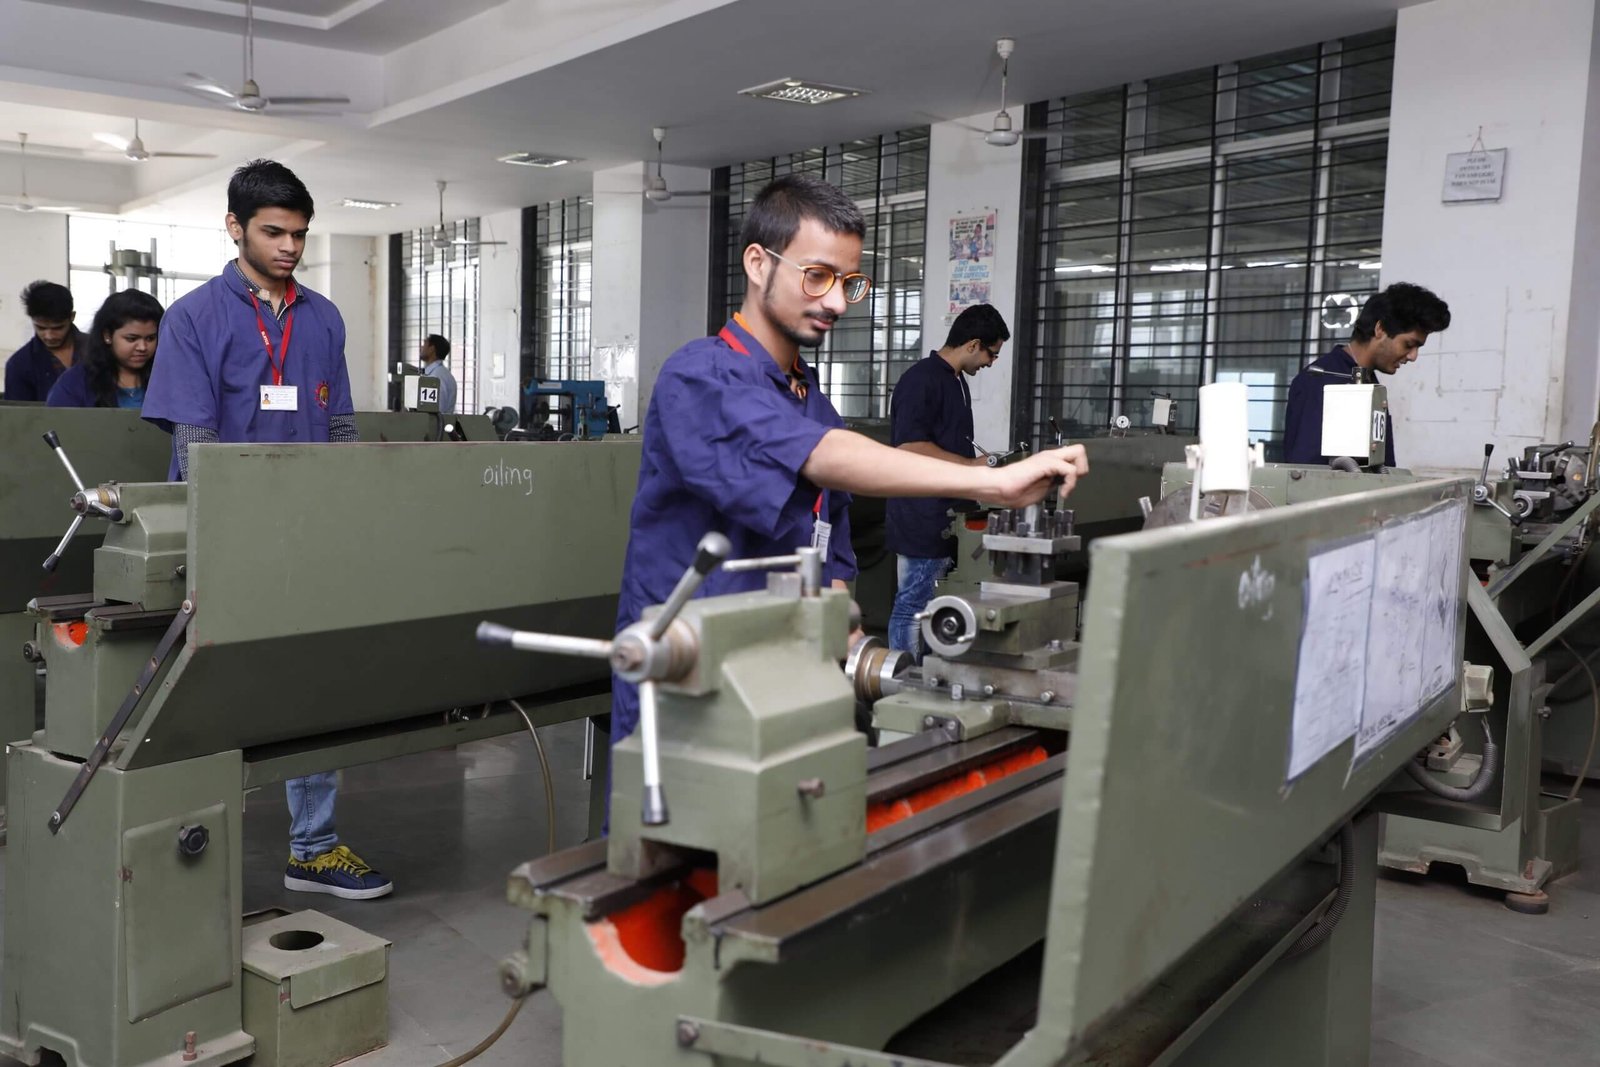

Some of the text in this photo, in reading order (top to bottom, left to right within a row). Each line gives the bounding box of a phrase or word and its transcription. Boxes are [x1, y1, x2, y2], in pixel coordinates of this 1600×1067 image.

[421, 388, 437, 401] 14
[1374, 413, 1384, 440] 16
[483, 457, 533, 495] oiling
